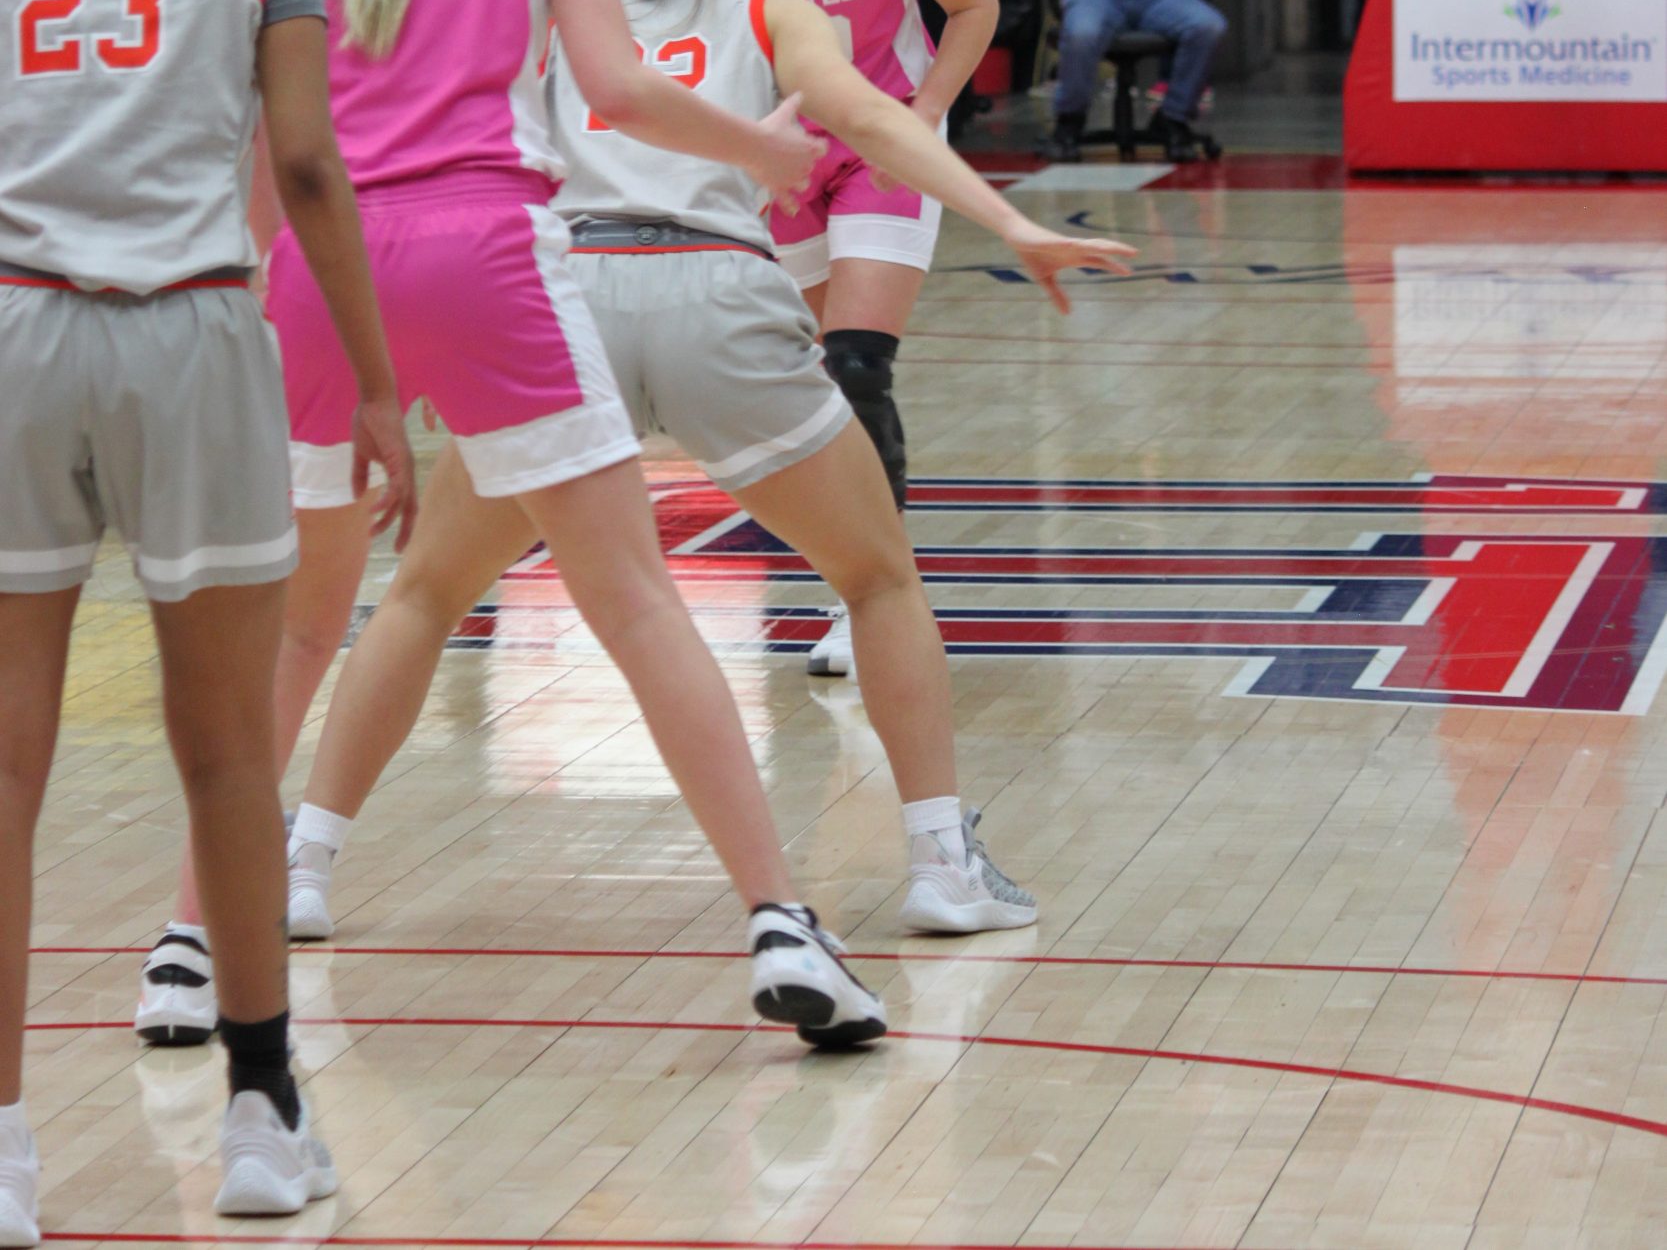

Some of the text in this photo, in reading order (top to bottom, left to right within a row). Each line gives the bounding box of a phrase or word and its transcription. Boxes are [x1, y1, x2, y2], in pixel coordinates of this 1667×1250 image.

[1410, 33, 1652, 62] Intermountain
[1431, 65, 1632, 92] Sports Medicine
